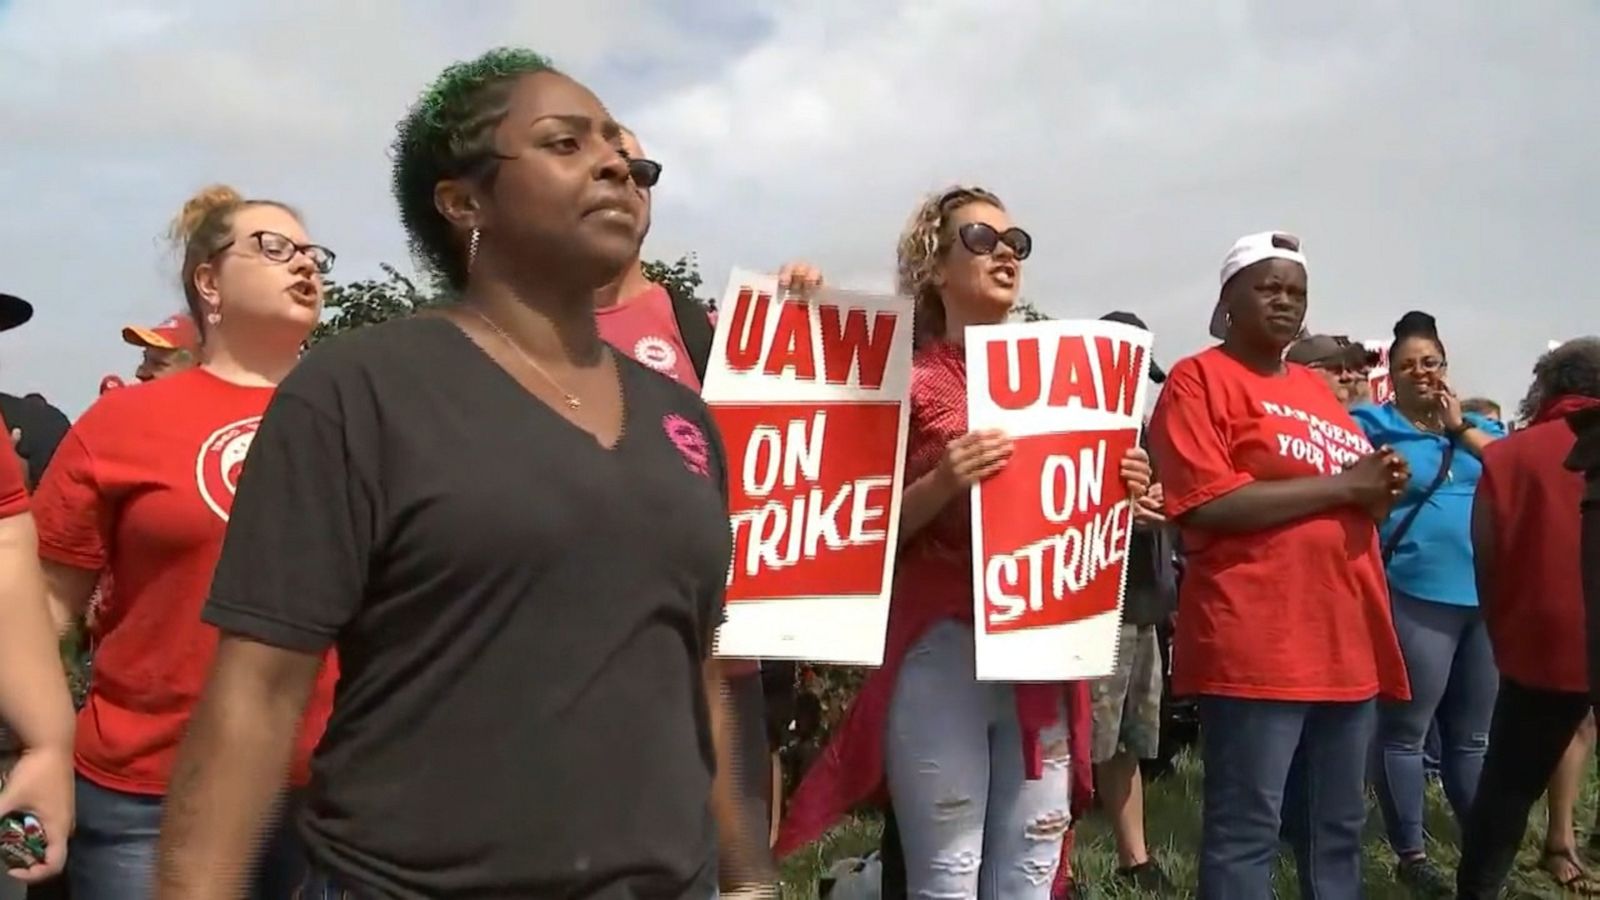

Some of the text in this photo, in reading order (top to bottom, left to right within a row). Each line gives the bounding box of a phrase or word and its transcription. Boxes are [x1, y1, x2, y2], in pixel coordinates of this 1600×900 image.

[726, 286, 898, 390] UAW
[986, 335, 1145, 417] UAW
[743, 410, 827, 498] ON
[1261, 400, 1376, 455] MANAGEME
[1276, 433, 1325, 474] YOUR
[1040, 440, 1106, 522] ON
[727, 475, 892, 587] TRIKE
[986, 500, 1129, 624] STRIKE
